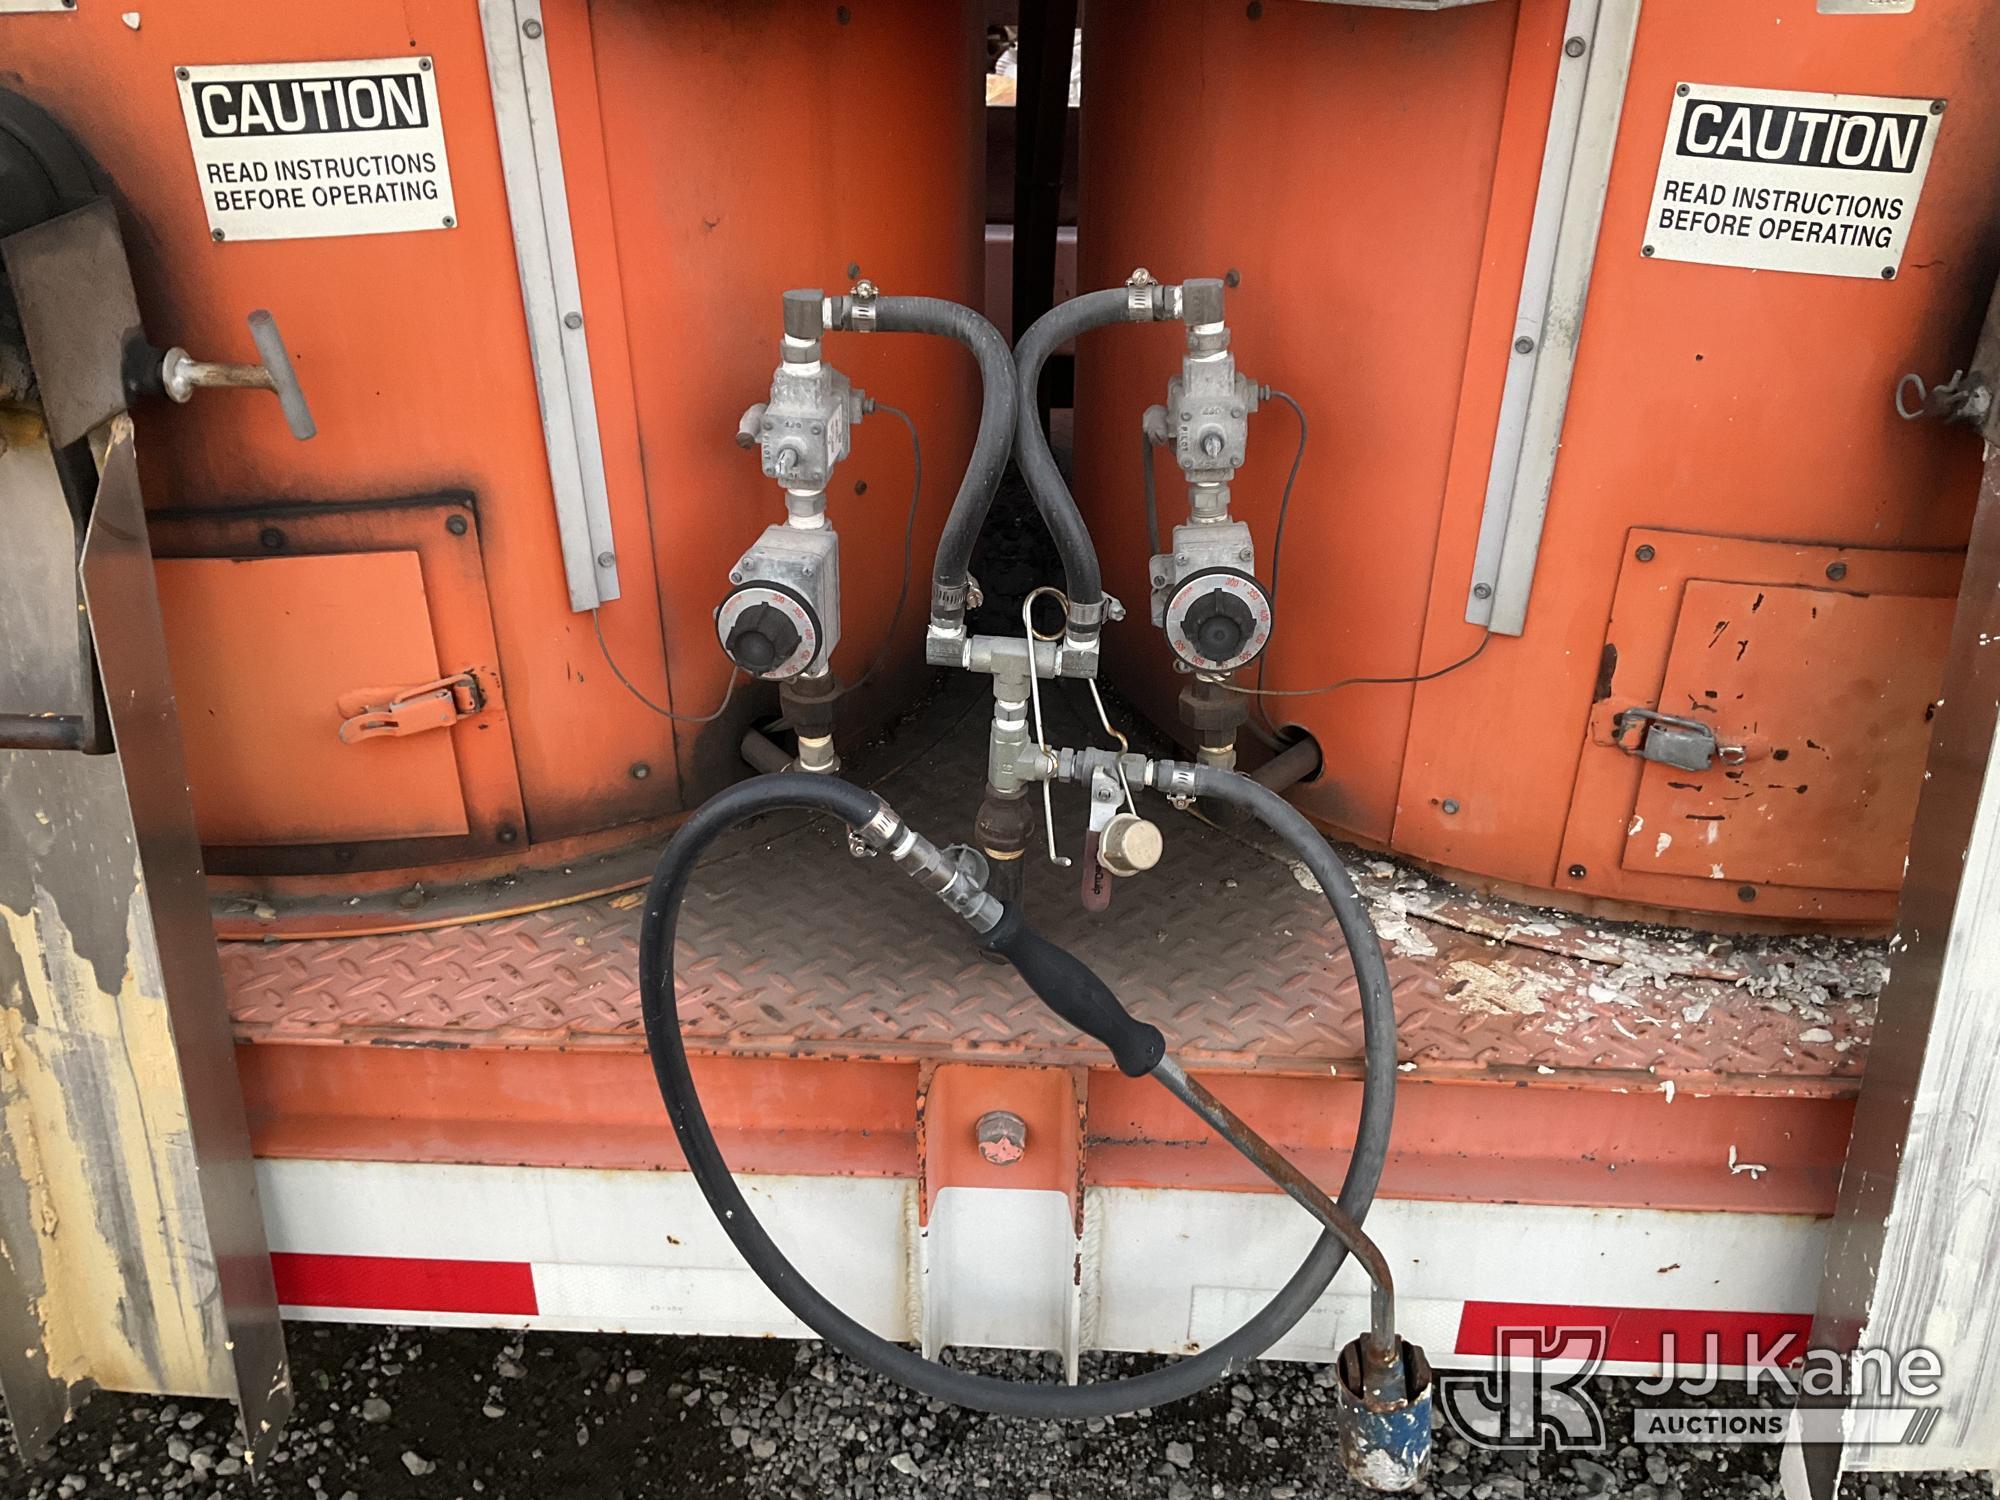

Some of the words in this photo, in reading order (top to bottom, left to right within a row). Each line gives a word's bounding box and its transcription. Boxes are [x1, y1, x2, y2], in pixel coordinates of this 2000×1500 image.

[201, 76, 422, 134] CAUTION
[1685, 103, 1919, 169] CAUTION
[206, 161, 268, 184] READ
[274, 152, 436, 182] INSTRUCTIONS
[214, 187, 305, 211] BEFORE
[312, 179, 438, 207] OPERATING
[1663, 180, 1726, 206] READ
[1732, 186, 1904, 220] INSTRUCTIONS
[1658, 208, 1753, 237] BEFORE
[1759, 217, 1893, 249] OPERATING
[1180, 426, 1189, 452] PILOT
